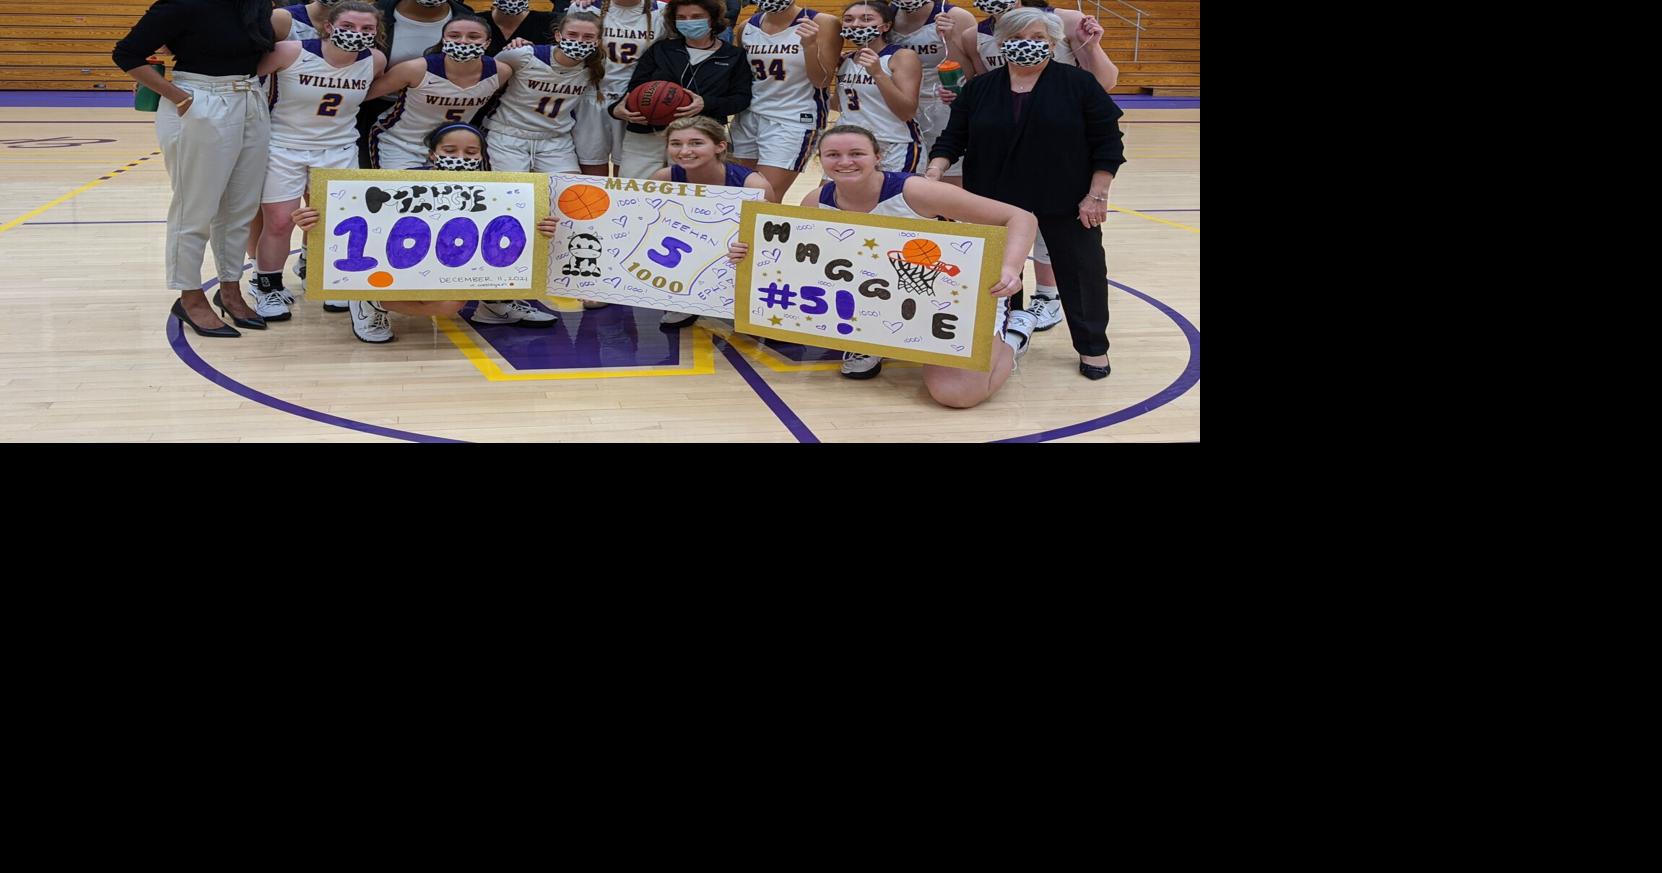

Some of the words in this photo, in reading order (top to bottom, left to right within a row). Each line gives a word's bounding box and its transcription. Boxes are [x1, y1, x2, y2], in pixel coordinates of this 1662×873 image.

[601, 27, 655, 41] ILLIAMS
[607, 41, 638, 64] 12
[751, 58, 786, 81] 34
[837, 73, 877, 85] LLIAM
[299, 74, 367, 91] WILLIAMS
[316, 92, 344, 117] 2
[534, 96, 566, 119] 11
[844, 87, 860, 111] 3
[604, 178, 708, 198] MAGGIE
[661, 216, 720, 247] MEEHAN
[333, 215, 527, 272] 1000
[647, 236, 693, 269] 5
[439, 275, 491, 285] DECEMBER
[627, 261, 684, 294] 1000
[762, 220, 960, 341] MAGGIE
[757, 282, 856, 335] #5!
